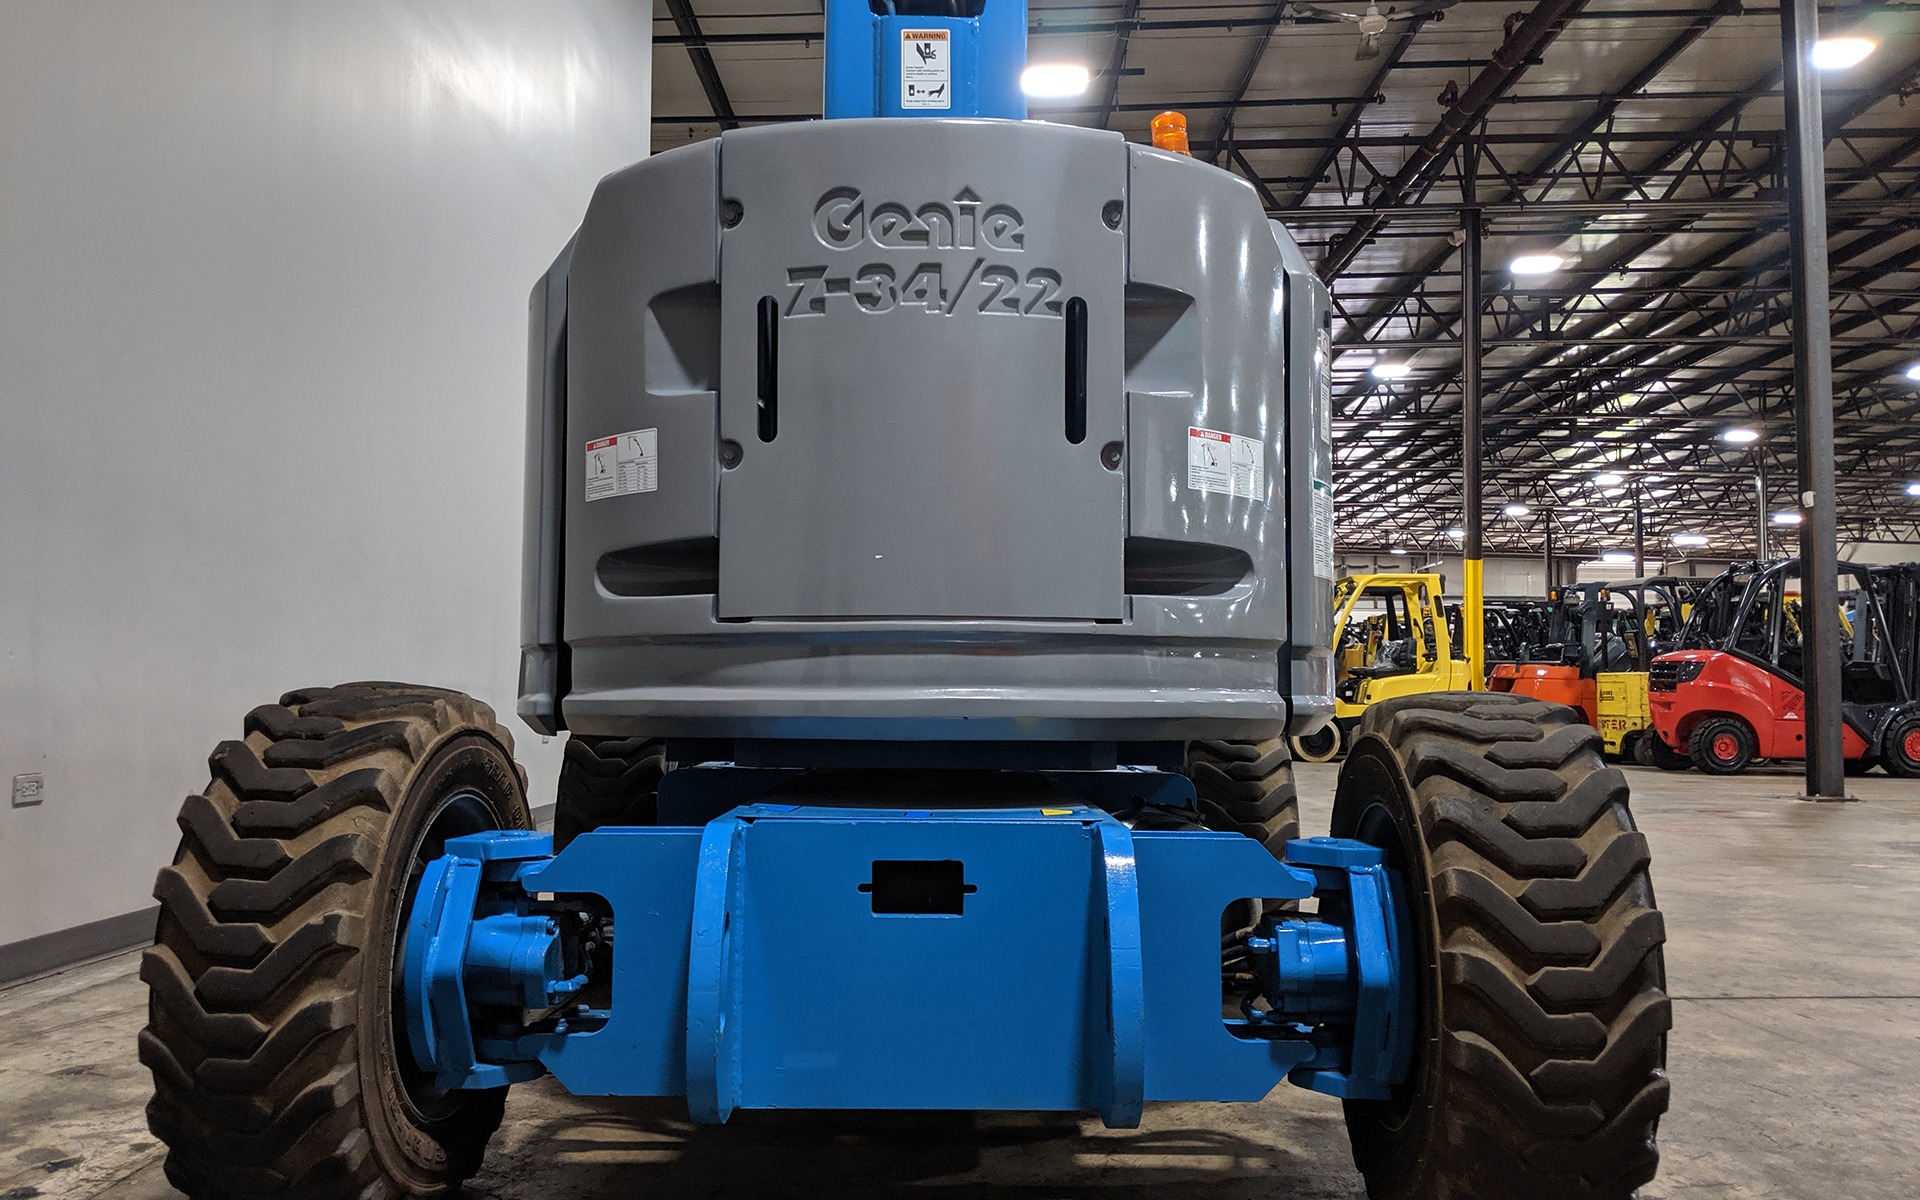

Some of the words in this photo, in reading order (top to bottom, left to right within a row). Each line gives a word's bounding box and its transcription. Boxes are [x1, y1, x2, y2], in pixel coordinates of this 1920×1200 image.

[811, 184, 1025, 252] Genie
[784, 257, 1063, 319] Z-34/22
[1600, 719, 1627, 730] STER
